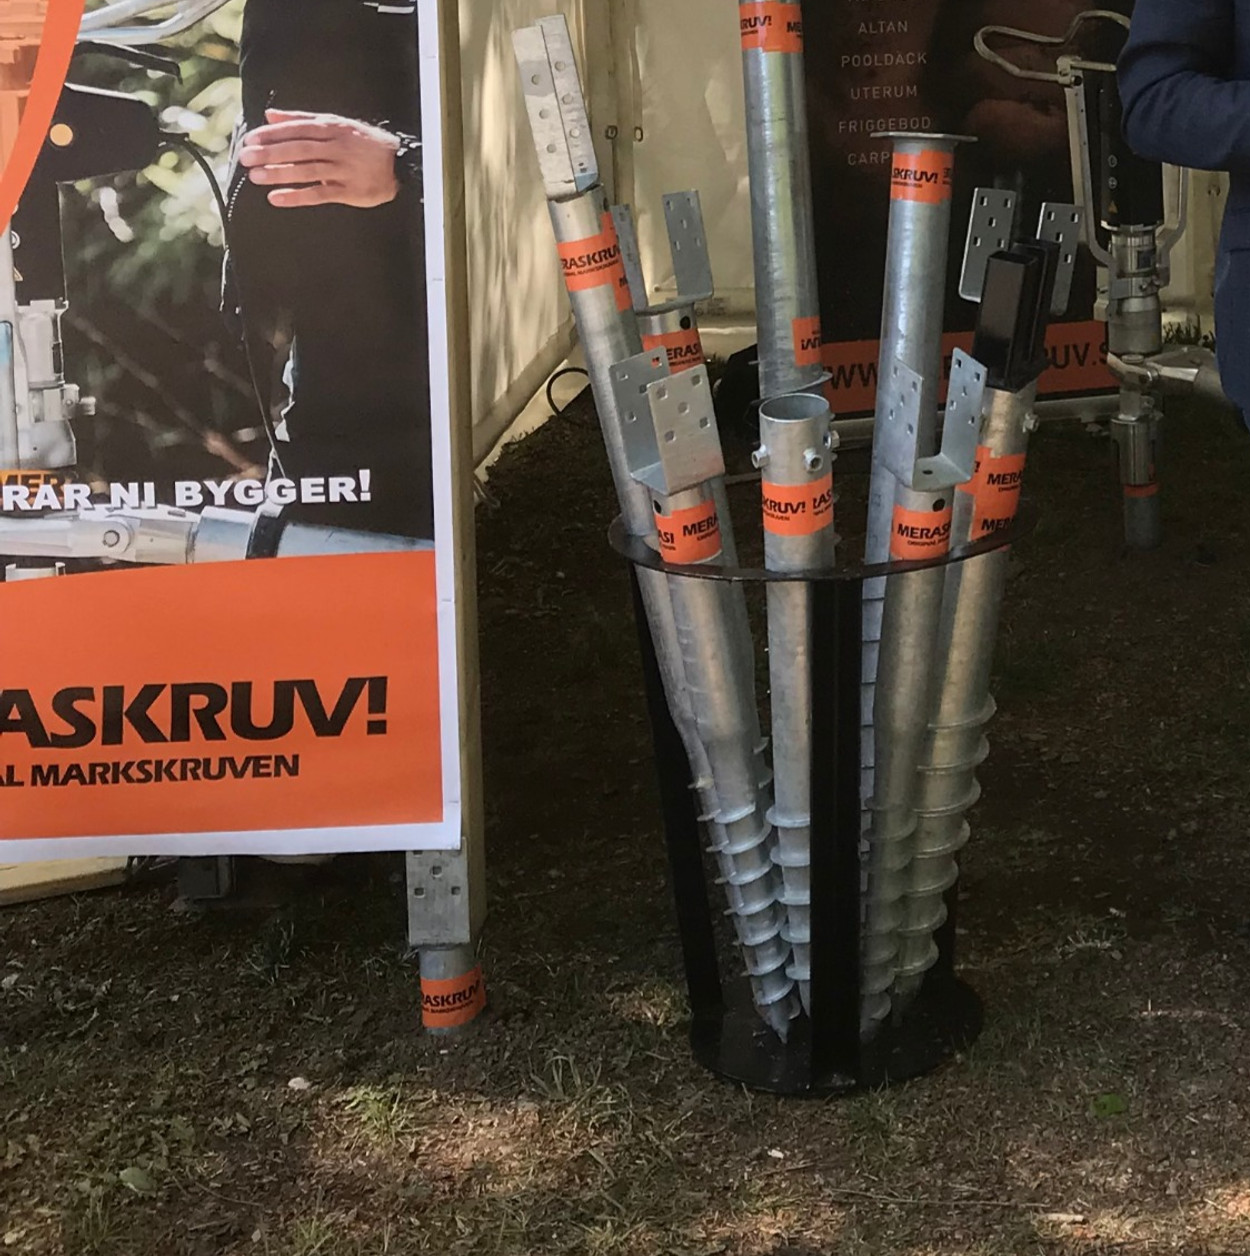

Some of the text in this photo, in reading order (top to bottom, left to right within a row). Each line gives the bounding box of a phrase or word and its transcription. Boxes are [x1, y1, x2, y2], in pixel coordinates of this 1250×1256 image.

[858, 19, 908, 35] ALTAN
[850, 85, 918, 100] UTERUM
[838, 116, 931, 135] FRIGGEBOD
[847, 152, 890, 166] CARP
[109, 482, 156, 509] NI
[174, 468, 372, 508] BYGGER!
[31, 754, 300, 787] MARKSKRUVEN
